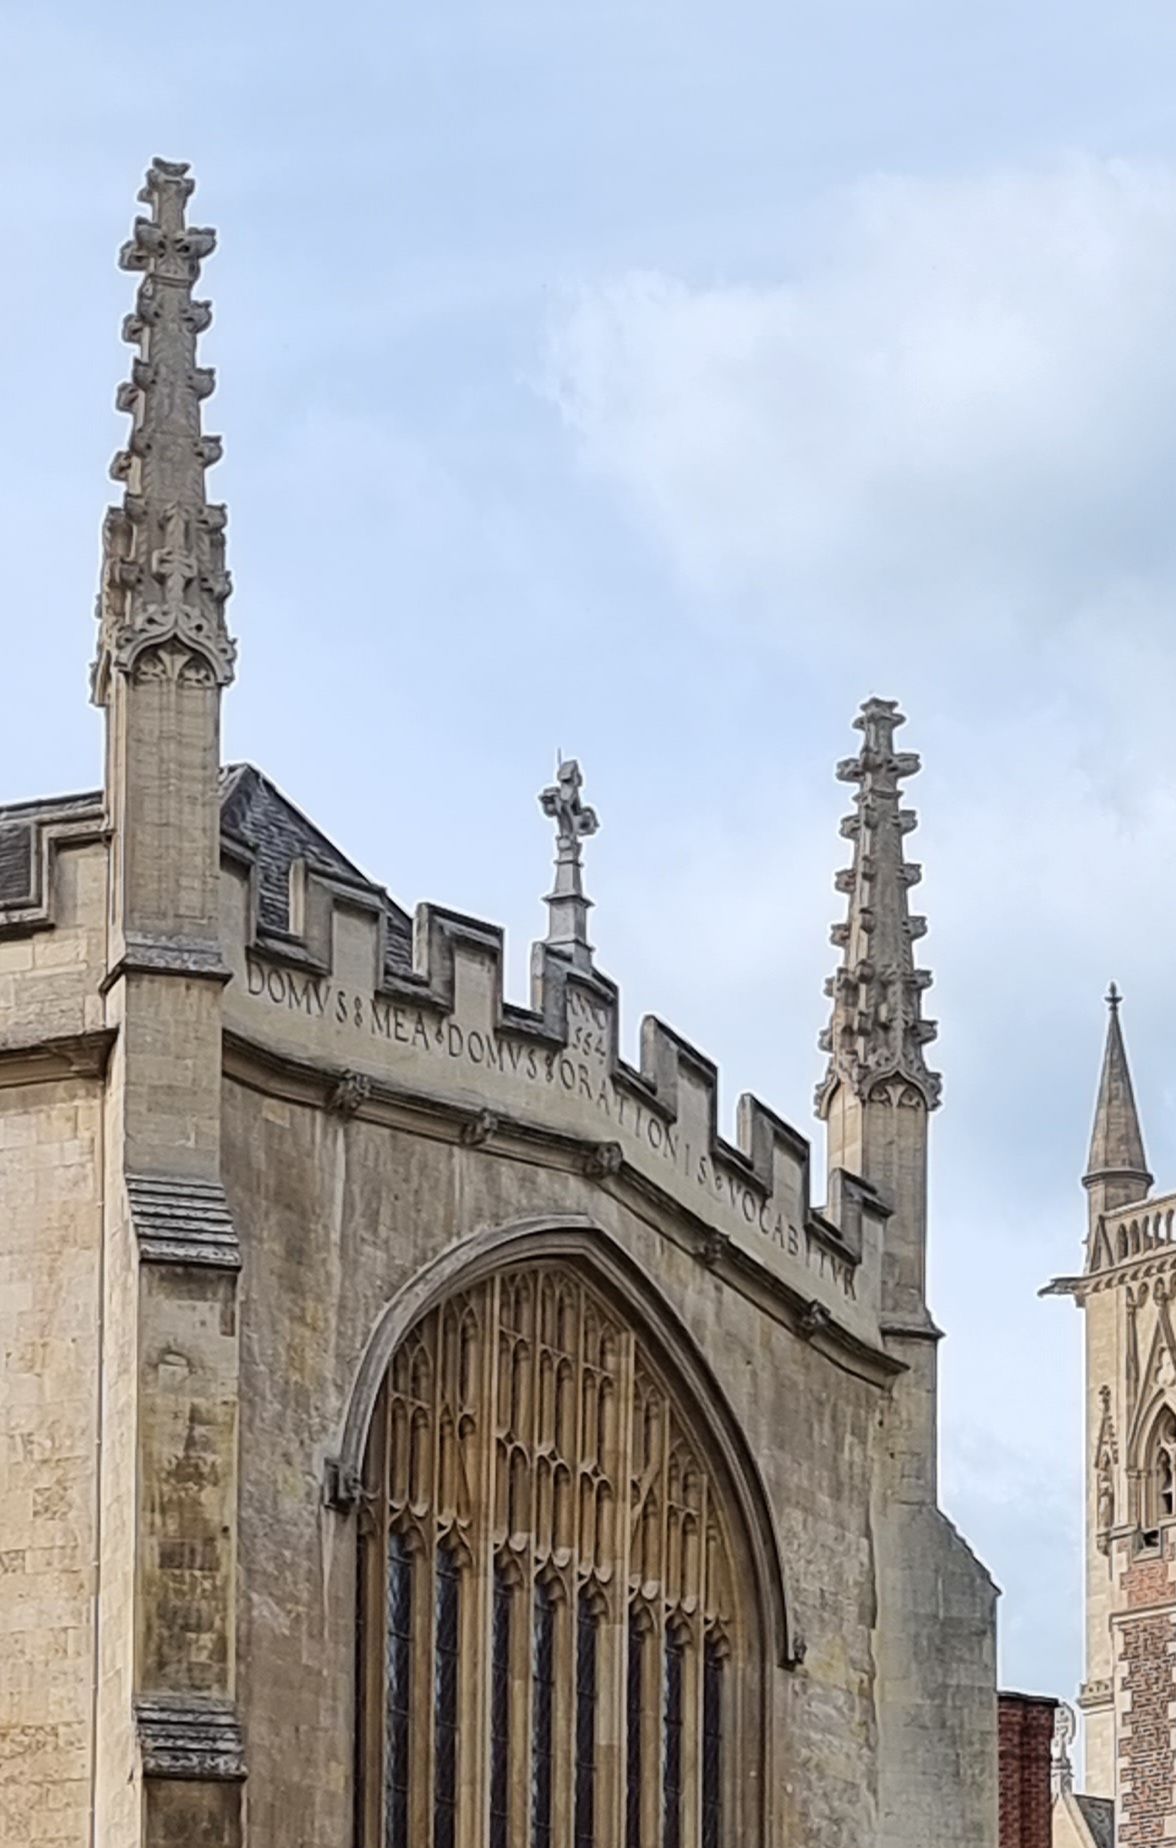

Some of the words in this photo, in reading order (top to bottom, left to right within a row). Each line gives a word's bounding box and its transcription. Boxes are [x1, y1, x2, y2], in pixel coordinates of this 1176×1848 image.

[246, 959, 347, 1023] DOMVS
[370, 1000, 430, 1050] MEA
[449, 1024, 537, 1079] DOMVS
